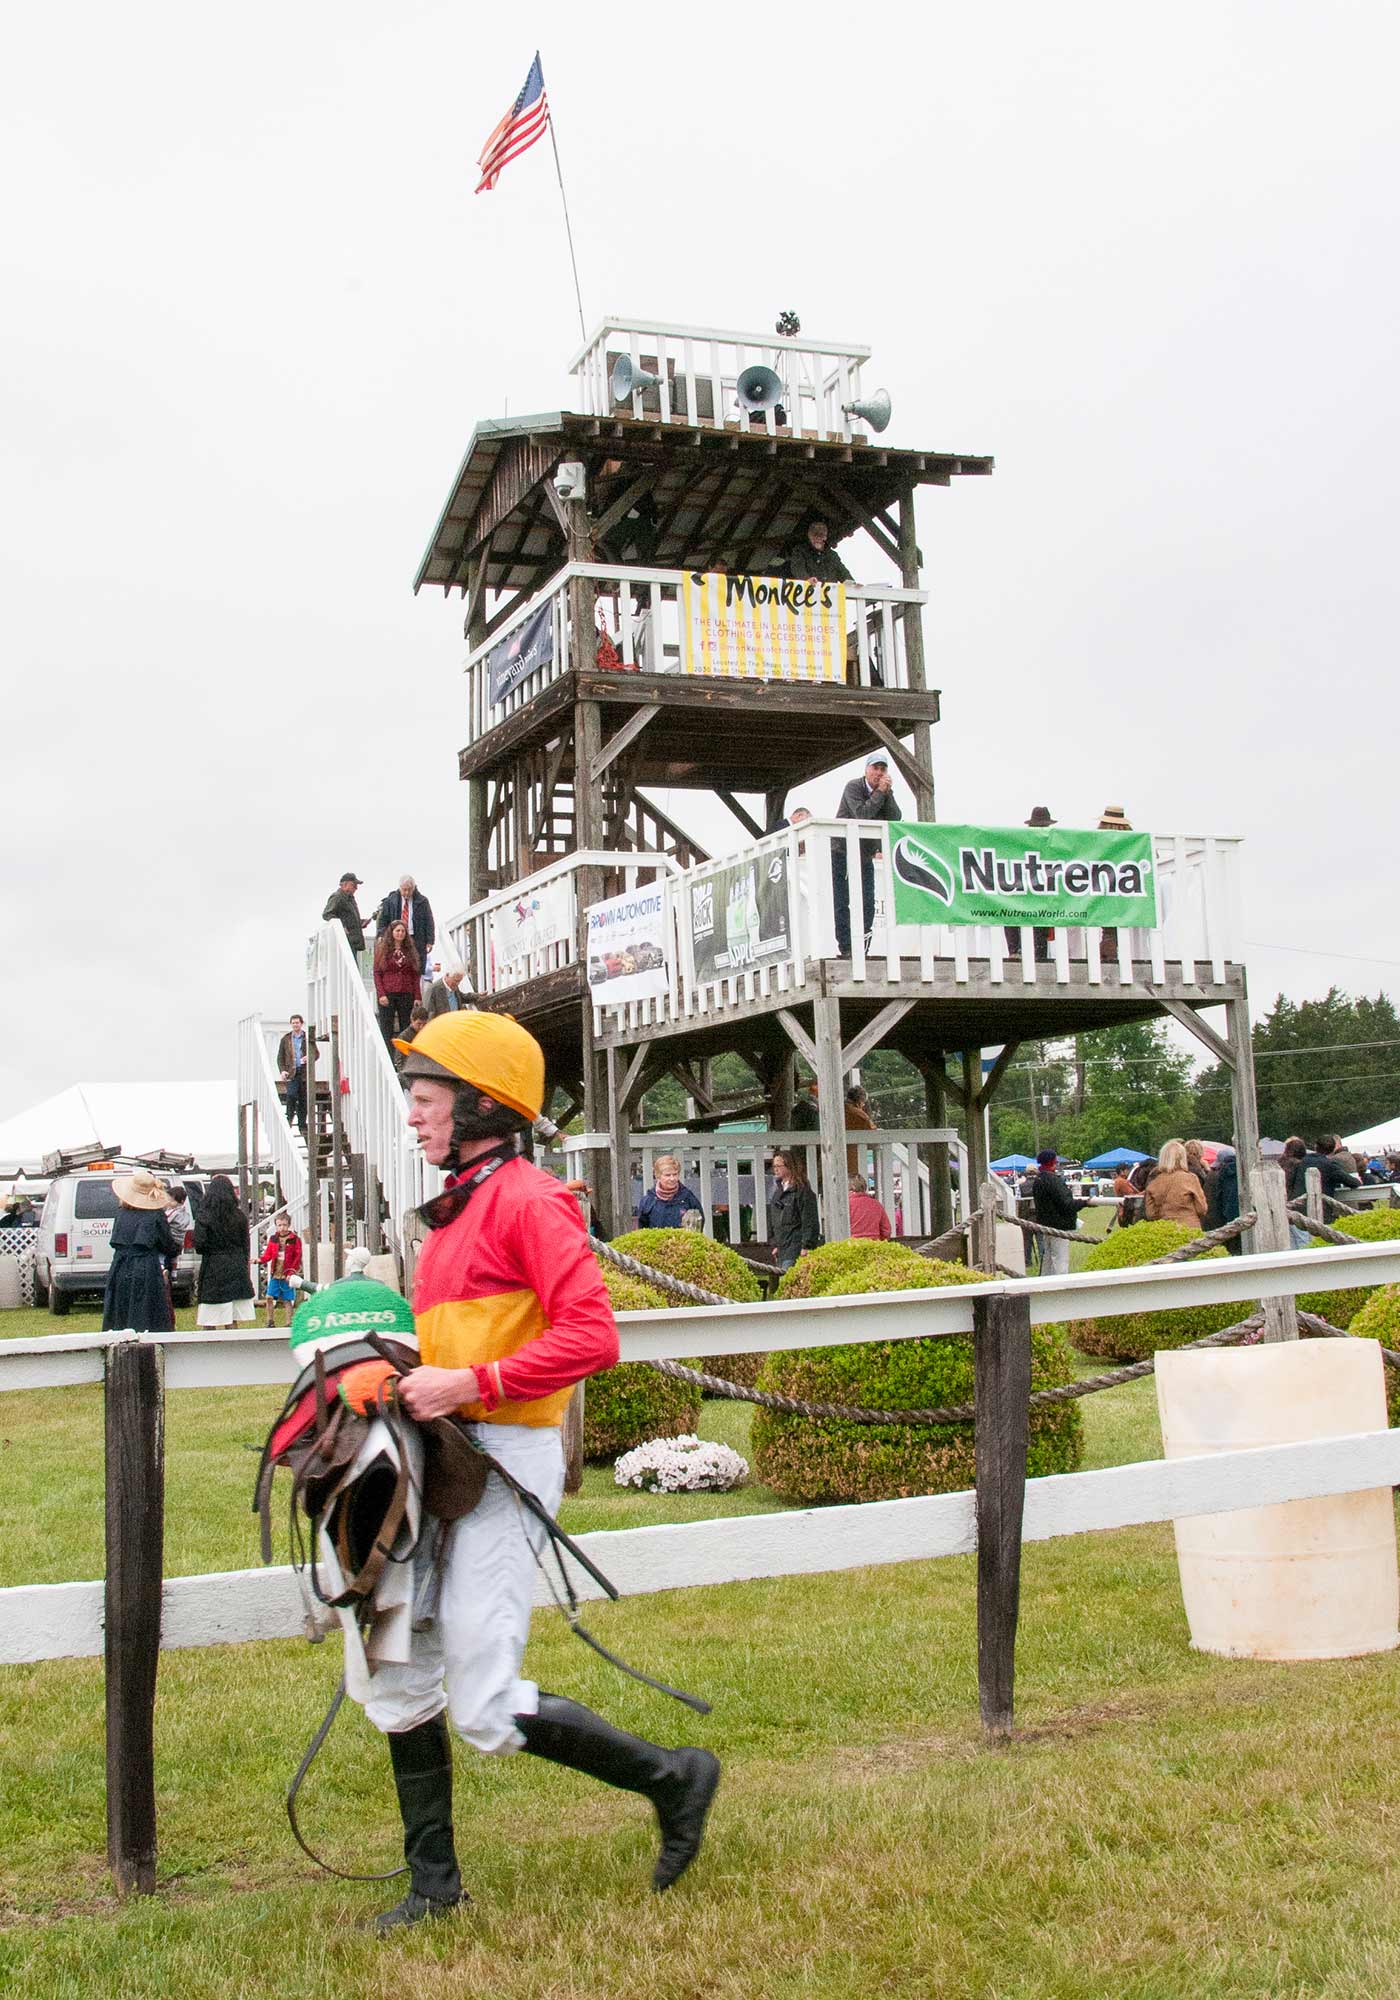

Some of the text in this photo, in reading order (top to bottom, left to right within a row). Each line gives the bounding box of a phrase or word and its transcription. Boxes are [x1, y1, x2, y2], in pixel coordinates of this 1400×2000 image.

[726, 575, 832, 615] Monkee's
[694, 617, 711, 626] THE
[714, 618, 756, 629] ULTIMATE
[760, 621, 768, 630] IN
[771, 623, 801, 632] LADIES
[705, 629, 752, 638] CLOTHING
[765, 632, 826, 643] ACCESSORIES
[959, 848, 1147, 897] Nutrena
[590, 895, 662, 929] BROWN AUTOMOTIVE
[970, 907, 1088, 919] www.NutrenaWorld.com
[729, 943, 755, 968] APPLE
[306, 1309, 396, 1333] GERRY G
